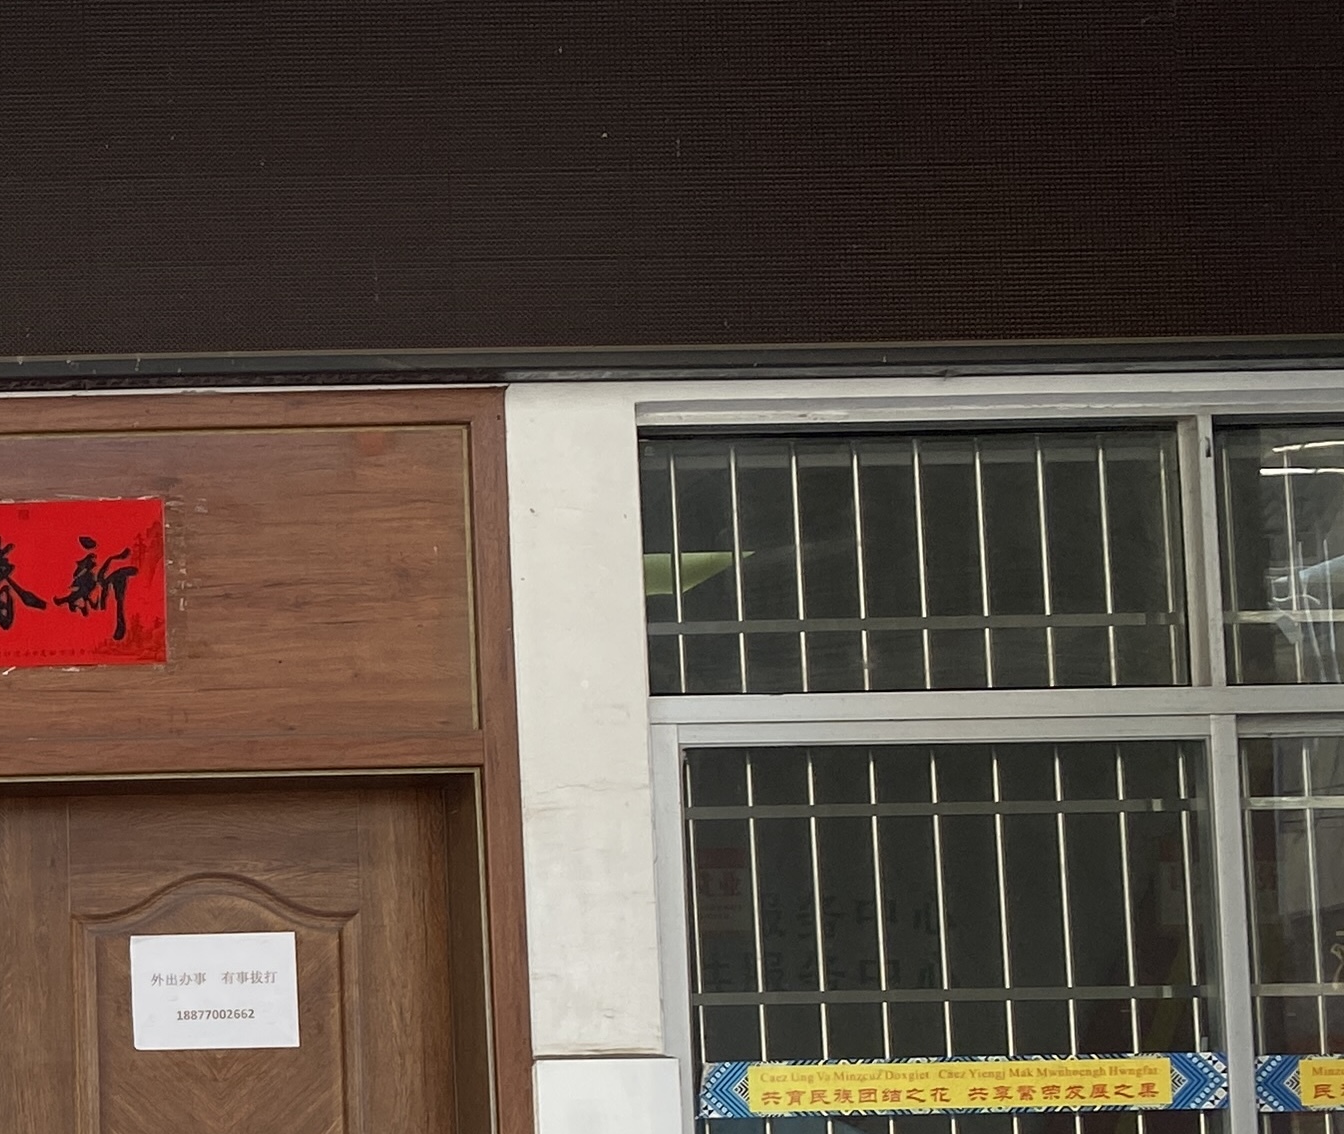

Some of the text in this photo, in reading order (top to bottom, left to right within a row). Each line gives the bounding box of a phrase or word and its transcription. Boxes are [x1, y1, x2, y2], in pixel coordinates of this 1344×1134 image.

[150, 972, 207, 987] 外出办事
[176, 1009, 255, 1021] 18877002662
[761, 1082, 1160, 1106] 共育民族团结之花 共享繁荣发展之果
